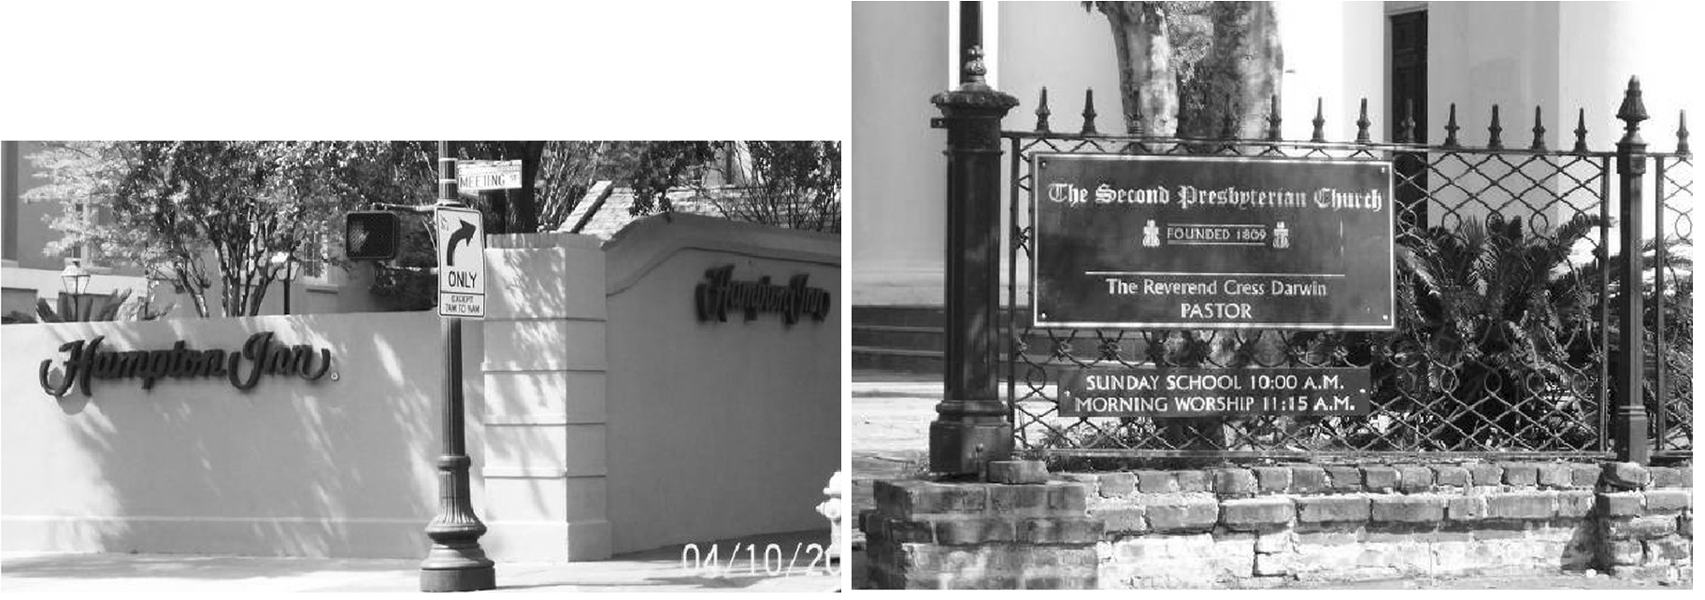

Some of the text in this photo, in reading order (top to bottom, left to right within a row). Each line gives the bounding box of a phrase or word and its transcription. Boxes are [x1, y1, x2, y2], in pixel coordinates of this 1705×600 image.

[459, 173, 505, 188] MEETING
[1048, 182, 1383, 212] The Second Presbyterian Church
[1166, 227, 1267, 241] FOUNDED 1809
[448, 270, 478, 289] ONLY
[1105, 277, 1327, 298] The Reverend Cress Darwin
[694, 264, 832, 326] Hampton Inn
[1180, 302, 1253, 320] PASTOR
[39, 332, 331, 397] Hampton Inn
[1085, 374, 1344, 391] SUNDAY SCHOOL 10:00 A.M.
[1074, 396, 1355, 413] MORNING WORSHIP 11:15 A.M.
